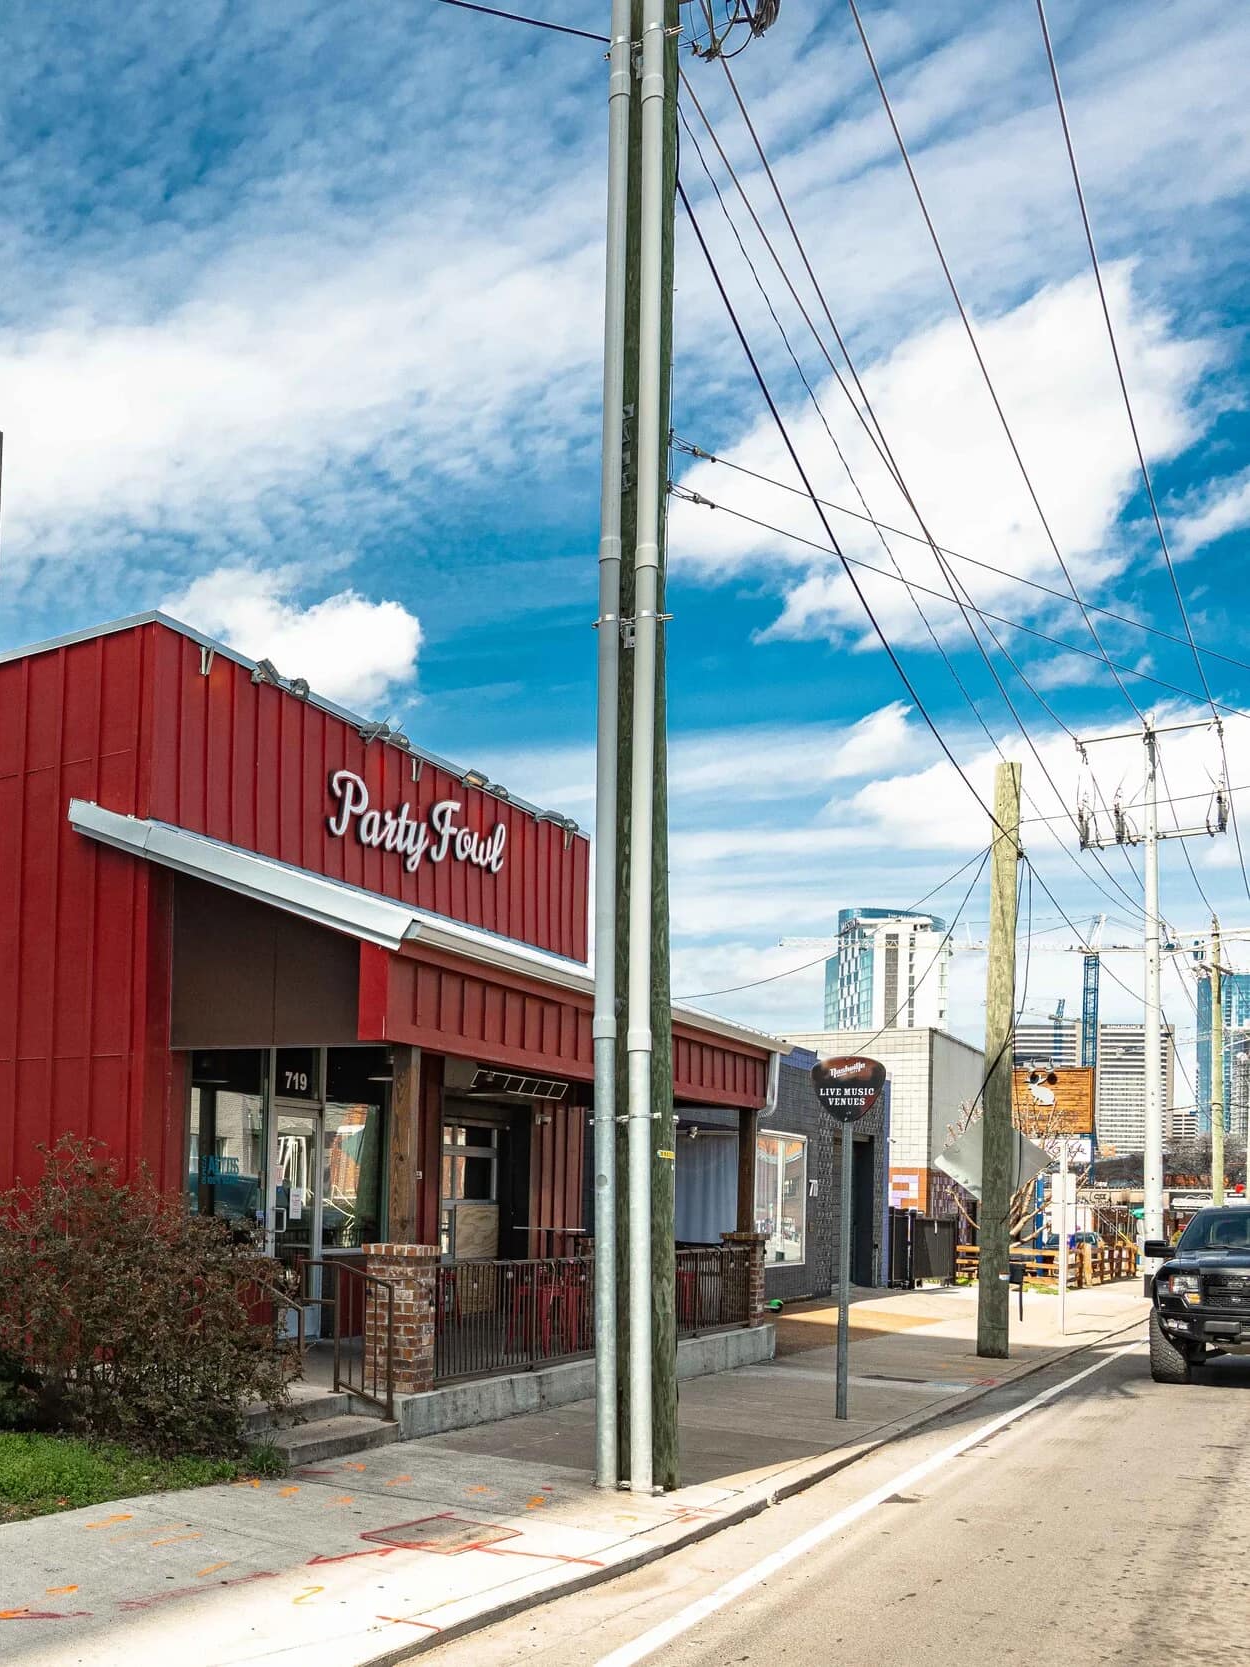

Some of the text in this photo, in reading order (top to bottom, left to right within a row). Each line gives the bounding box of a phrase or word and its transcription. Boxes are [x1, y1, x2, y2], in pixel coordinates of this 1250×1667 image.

[329, 770, 506, 873] Party Fowl
[285, 1071, 308, 1091] 719
[820, 1087, 875, 1096] LIVE MUSIC
[829, 1097, 866, 1106] VENUES
